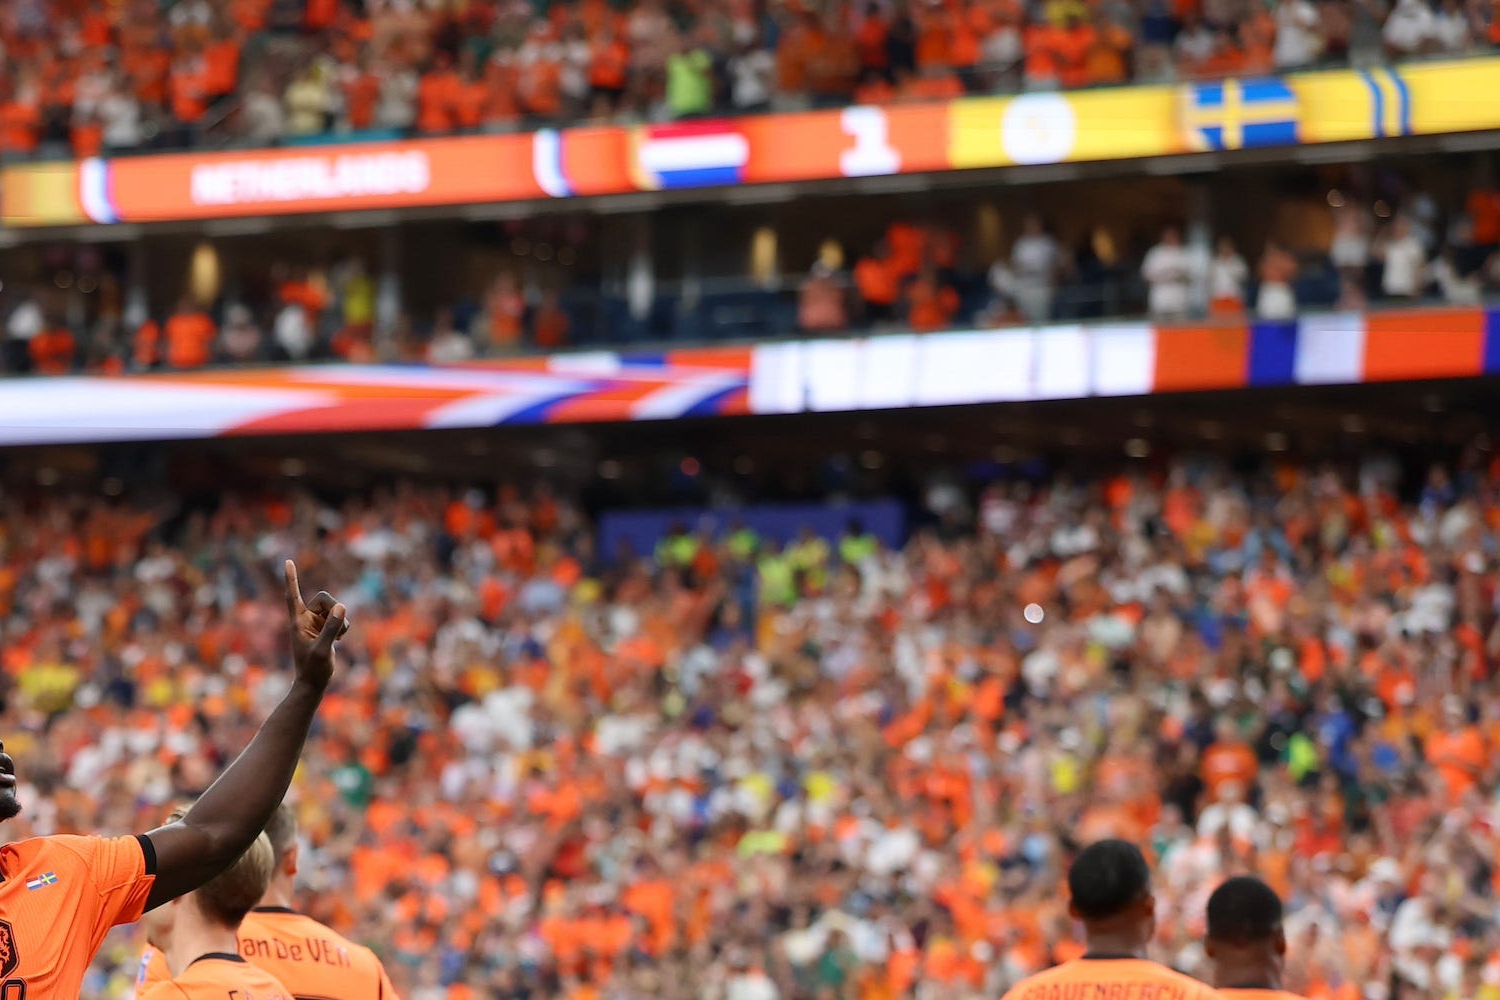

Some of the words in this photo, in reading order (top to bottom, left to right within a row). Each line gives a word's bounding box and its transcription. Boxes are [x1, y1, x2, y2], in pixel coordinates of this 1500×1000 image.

[192, 151, 430, 206] NETHERLANDS
[841, 106, 900, 176] 1
[273, 937, 302, 961] De
